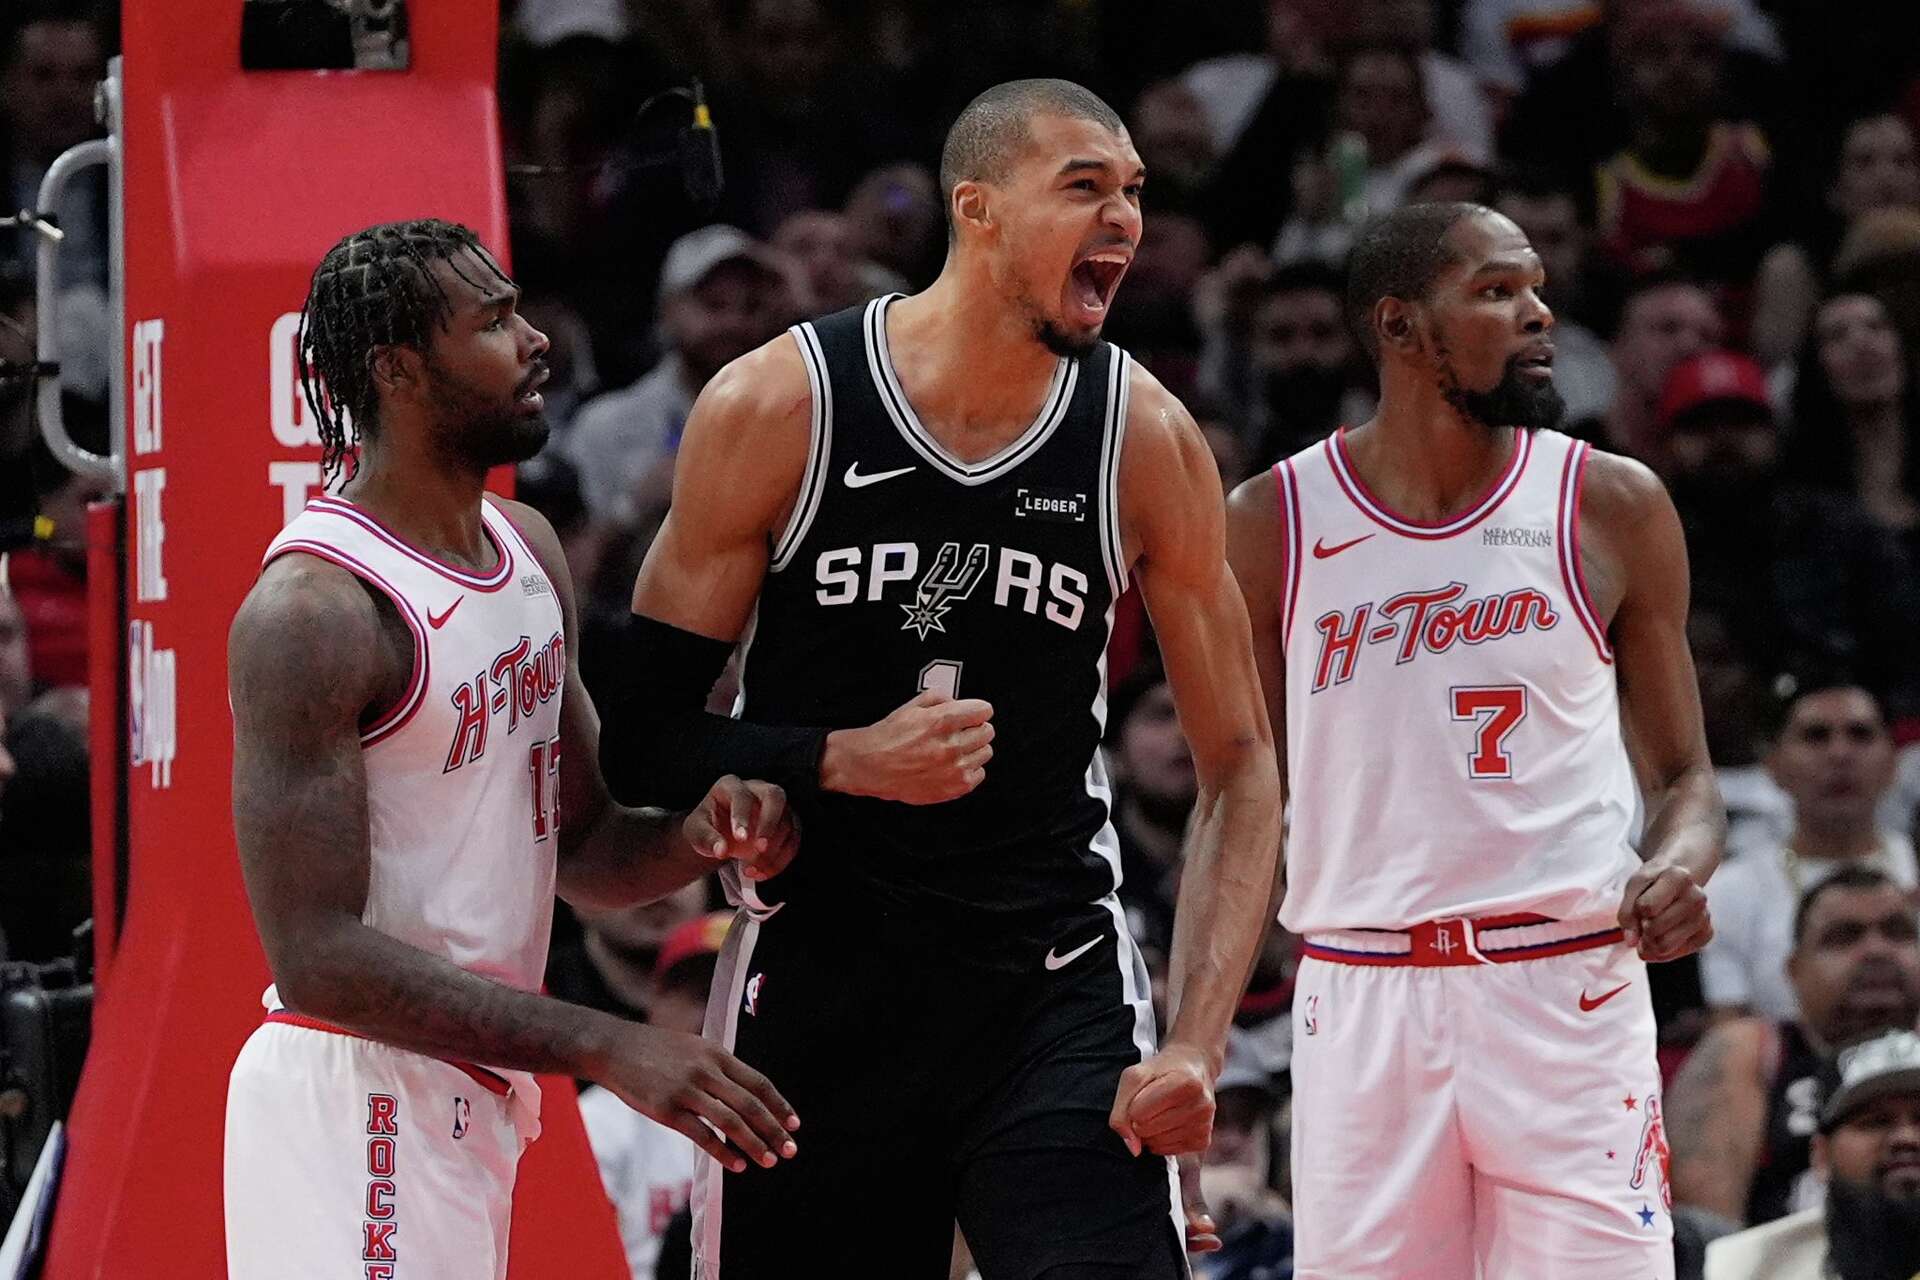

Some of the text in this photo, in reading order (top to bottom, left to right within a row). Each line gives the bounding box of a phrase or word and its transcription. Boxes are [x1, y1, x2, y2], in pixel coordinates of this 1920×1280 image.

[1025, 497, 1077, 513] LEDGER
[816, 542, 1089, 641] SPURS
[1311, 581, 1560, 694] H-Town
[1450, 685, 1527, 779] 7
